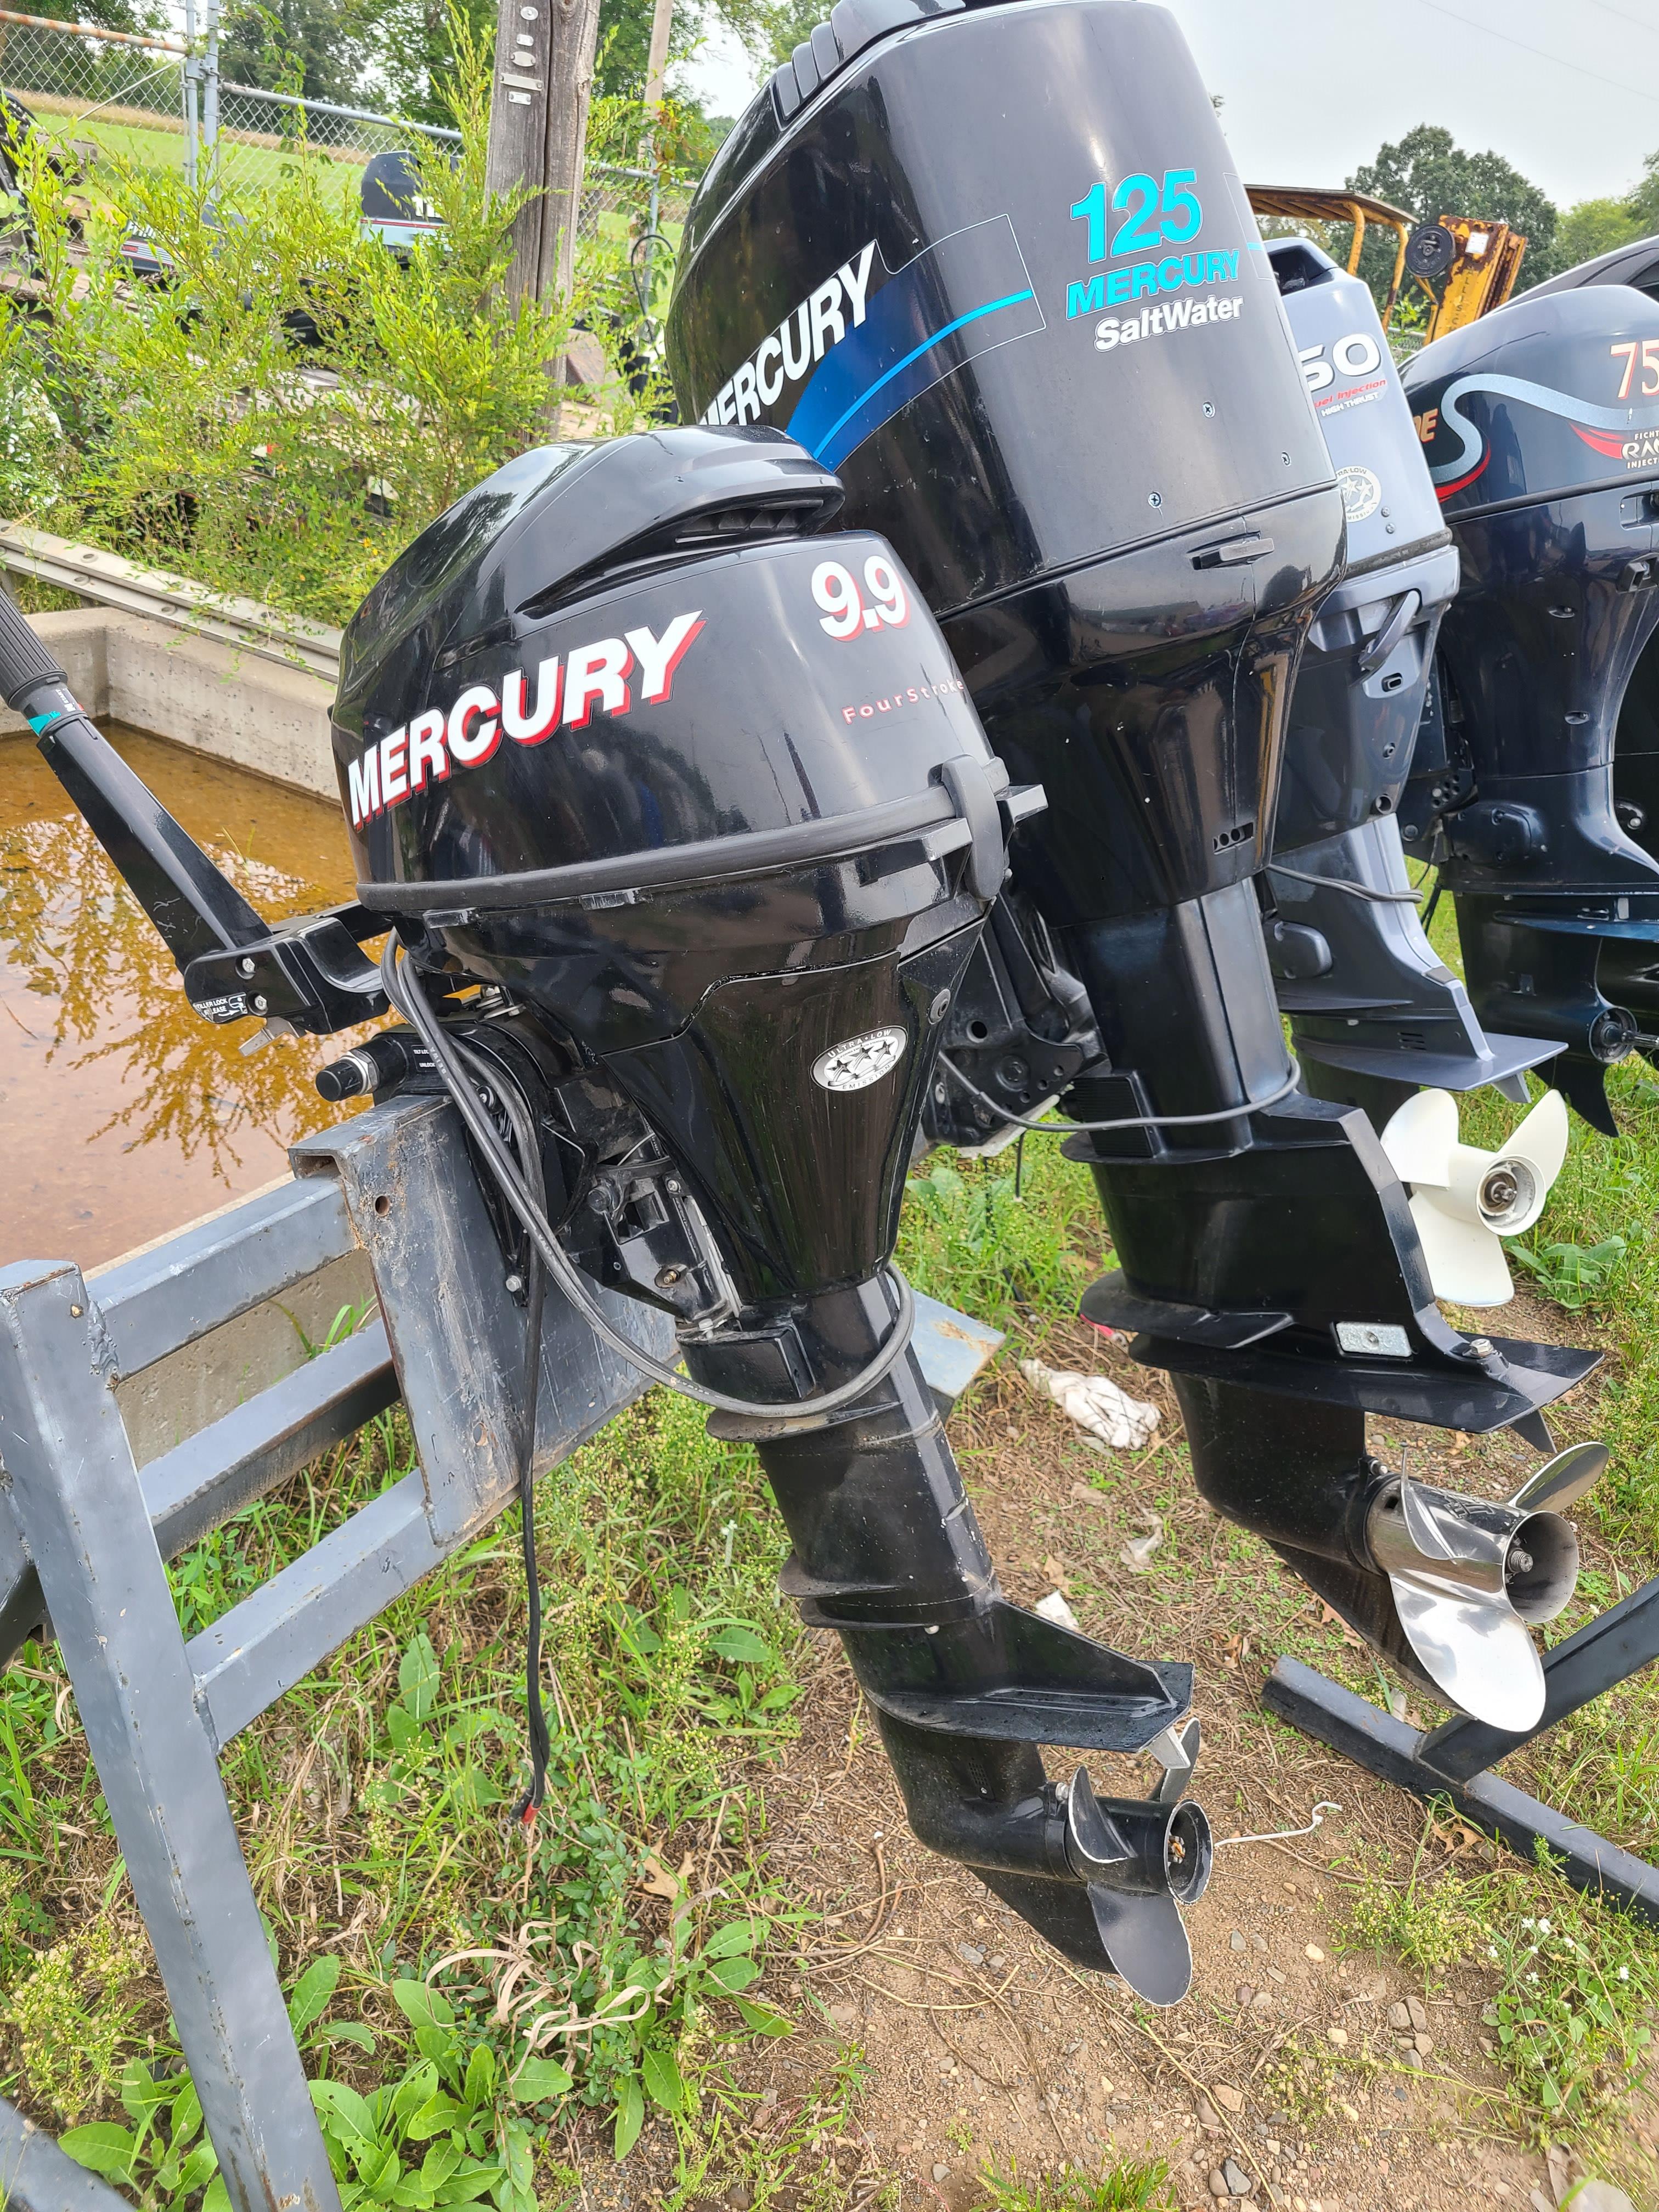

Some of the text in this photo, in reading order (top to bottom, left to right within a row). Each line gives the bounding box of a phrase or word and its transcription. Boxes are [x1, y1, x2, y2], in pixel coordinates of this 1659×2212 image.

[1070, 168, 1203, 264] 125
[1066, 249, 1239, 320] MERCURY
[1094, 295, 1243, 352] SaltWater
[1611, 339, 1659, 399] 75
[1314, 394, 1333, 408] uel
[1321, 392, 1379, 417] HIGH THRUST
[1627, 457, 1659, 469] INJECT
[811, 555, 911, 642] 9.9
[347, 610, 706, 831] MERCURY
[842, 679, 964, 725] FourStroke
[213, 998, 228, 1006] LOCK
[827, 1039, 863, 1058] ULTRA
[871, 1030, 891, 1039] LOW
[843, 1064, 890, 1090] EMISSION
